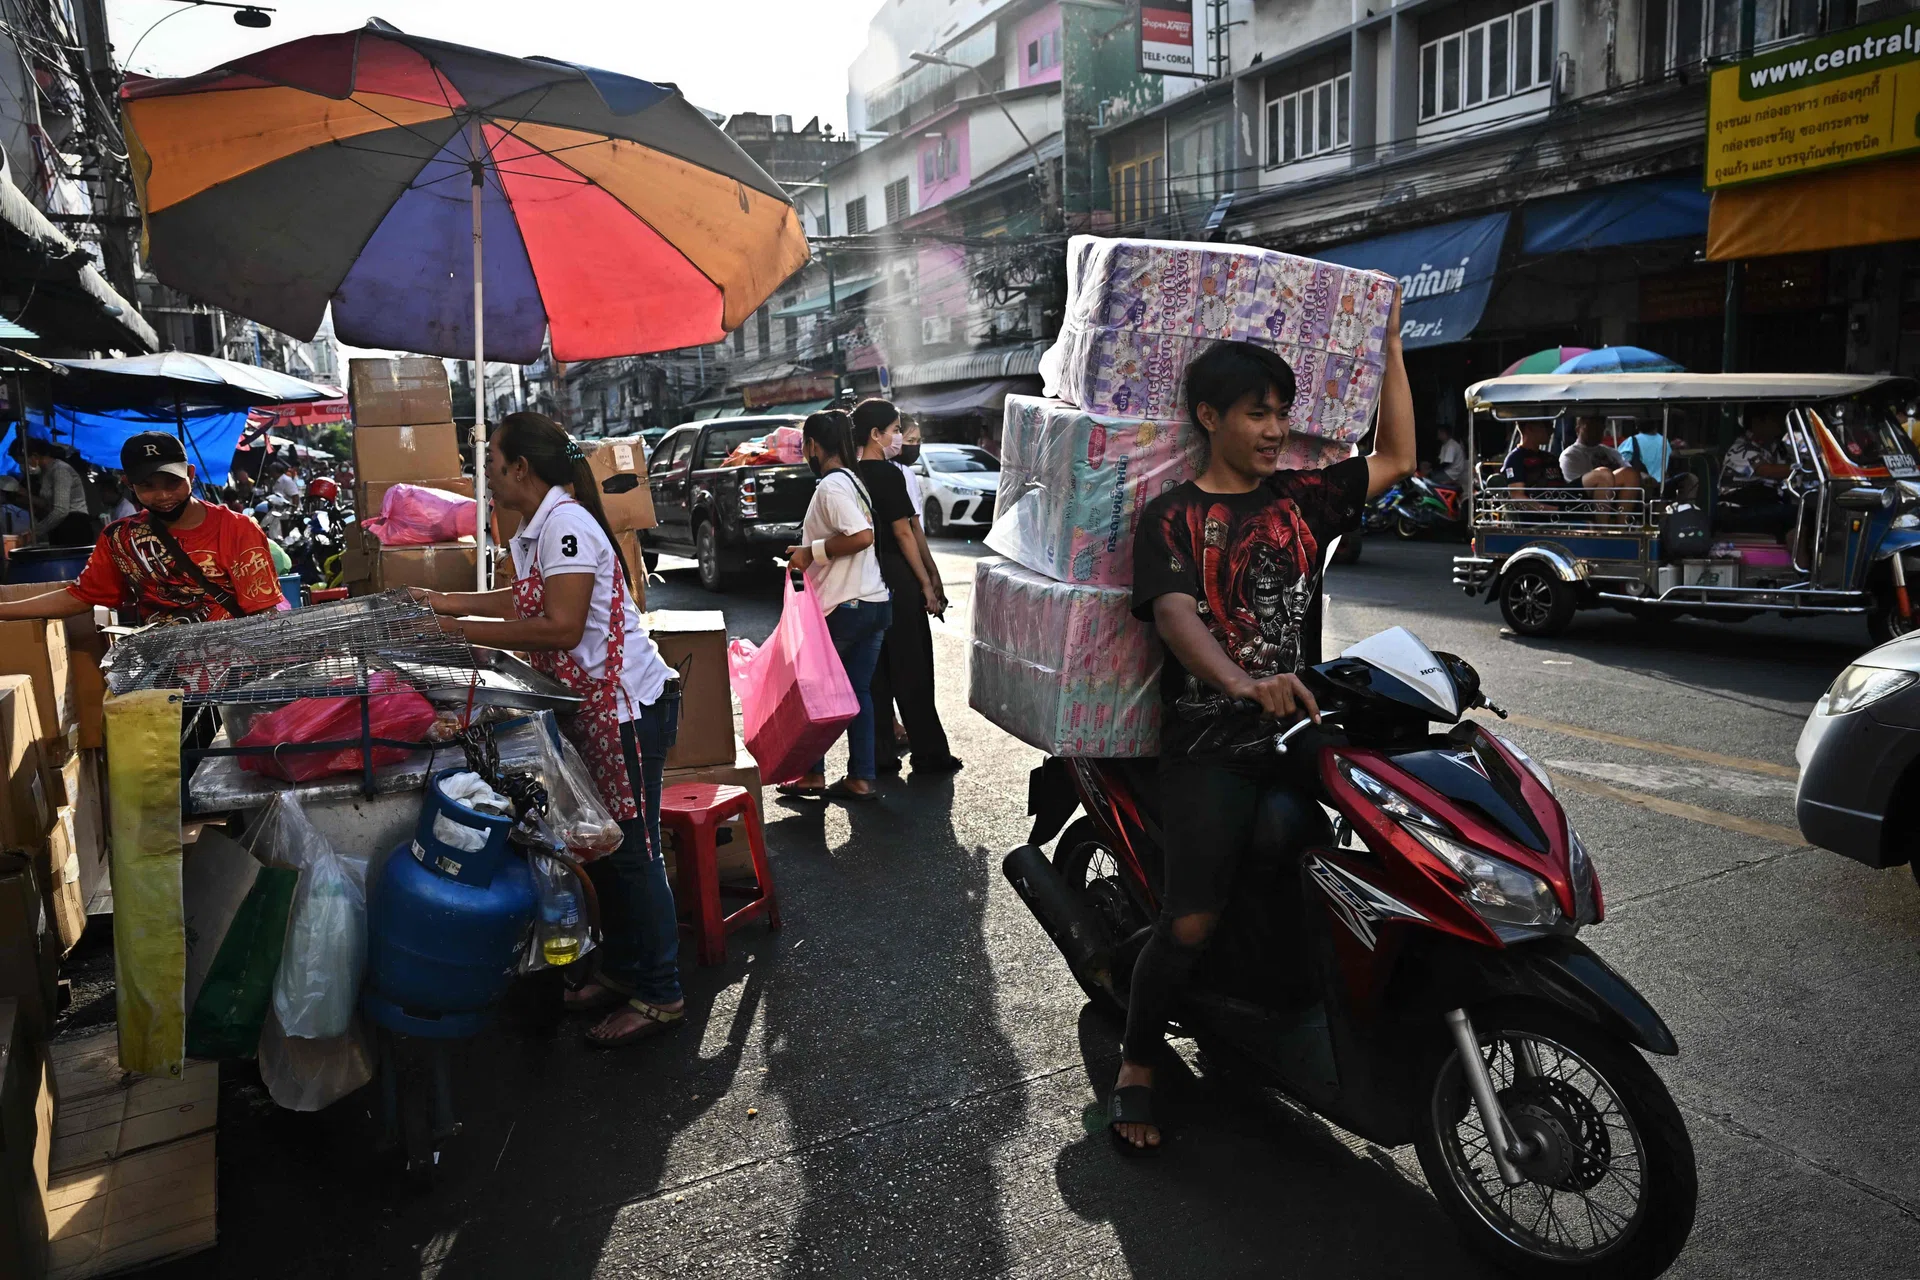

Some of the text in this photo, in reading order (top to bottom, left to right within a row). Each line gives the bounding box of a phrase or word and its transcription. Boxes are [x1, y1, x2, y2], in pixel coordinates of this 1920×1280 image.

[1143, 52, 1192, 65] TELE CORSA
[1716, 74, 1881, 135] ถุงขนม กล่องอาหาร กล่องคุกกี้
[1715, 134, 1880, 183] ถุงแก้ว และ บรรจุภัณฑ์ทุกชนิด
[1722, 112, 1870, 154] กล่องของขวัญ ซองกระดาษ
[1161, 265, 1177, 332] FACIAL
[1176, 250, 1189, 308] TISSUE
[1316, 268, 1331, 322] TISSUE
[1134, 304, 1144, 326] CUTE
[1272, 315, 1285, 336] CUTE
[1300, 281, 1319, 344] FACIAL
[1147, 353, 1161, 416] FACIAL
[1160, 340, 1173, 392] TISSUE
[1300, 353, 1317, 406] TISSUE
[1119, 389, 1129, 410] CUTE
[143, 443, 160, 457] R
[1107, 454, 1129, 553] กระดาษเช็ดหน้า
[561, 534, 578, 558] 3
